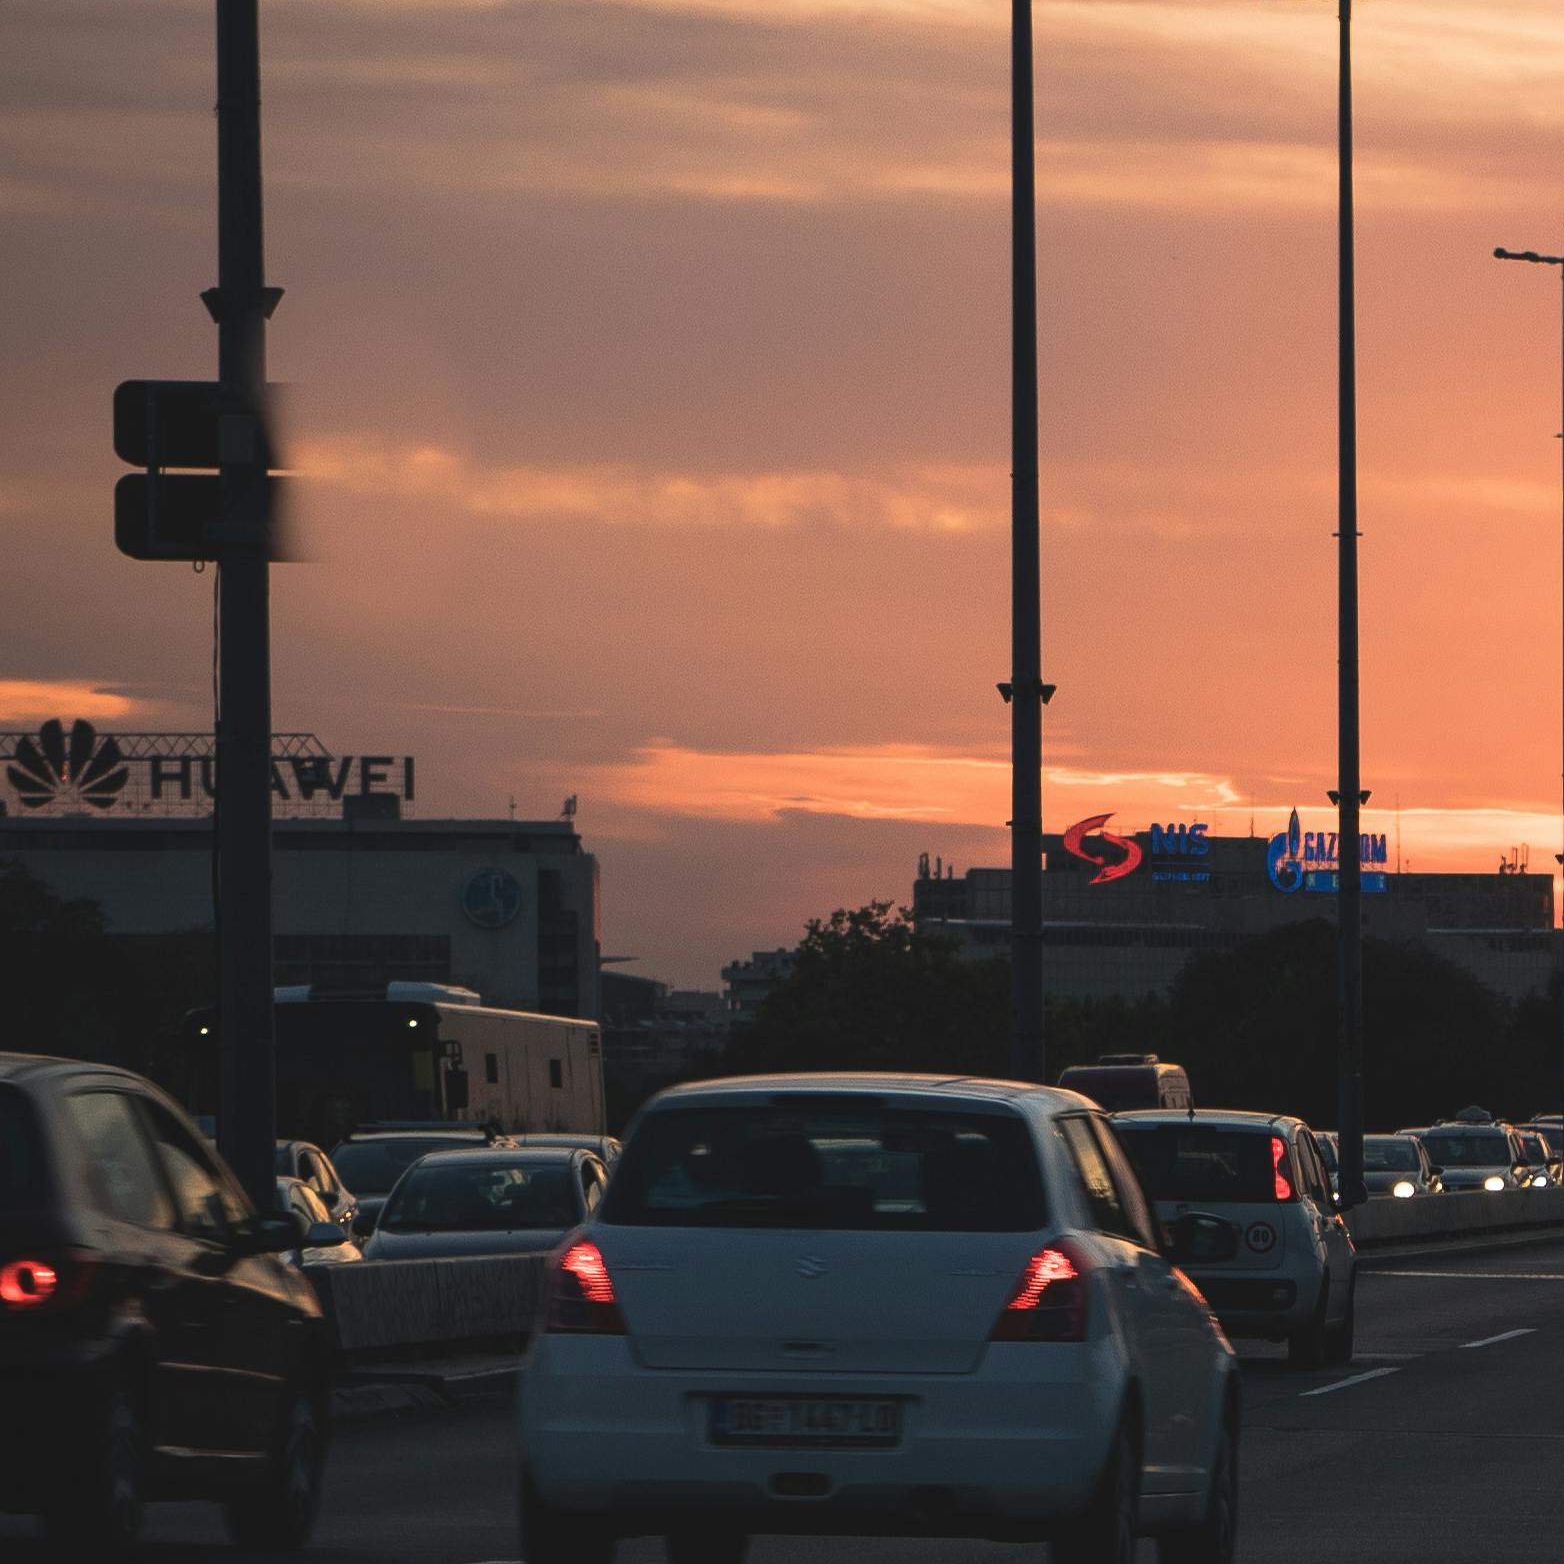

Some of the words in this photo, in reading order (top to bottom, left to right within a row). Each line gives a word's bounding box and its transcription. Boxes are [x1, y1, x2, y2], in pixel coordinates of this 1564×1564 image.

[1150, 823, 1209, 854] NIS
[1304, 832, 1387, 863] GAZOM
[1252, 1229, 1269, 1243] 80
